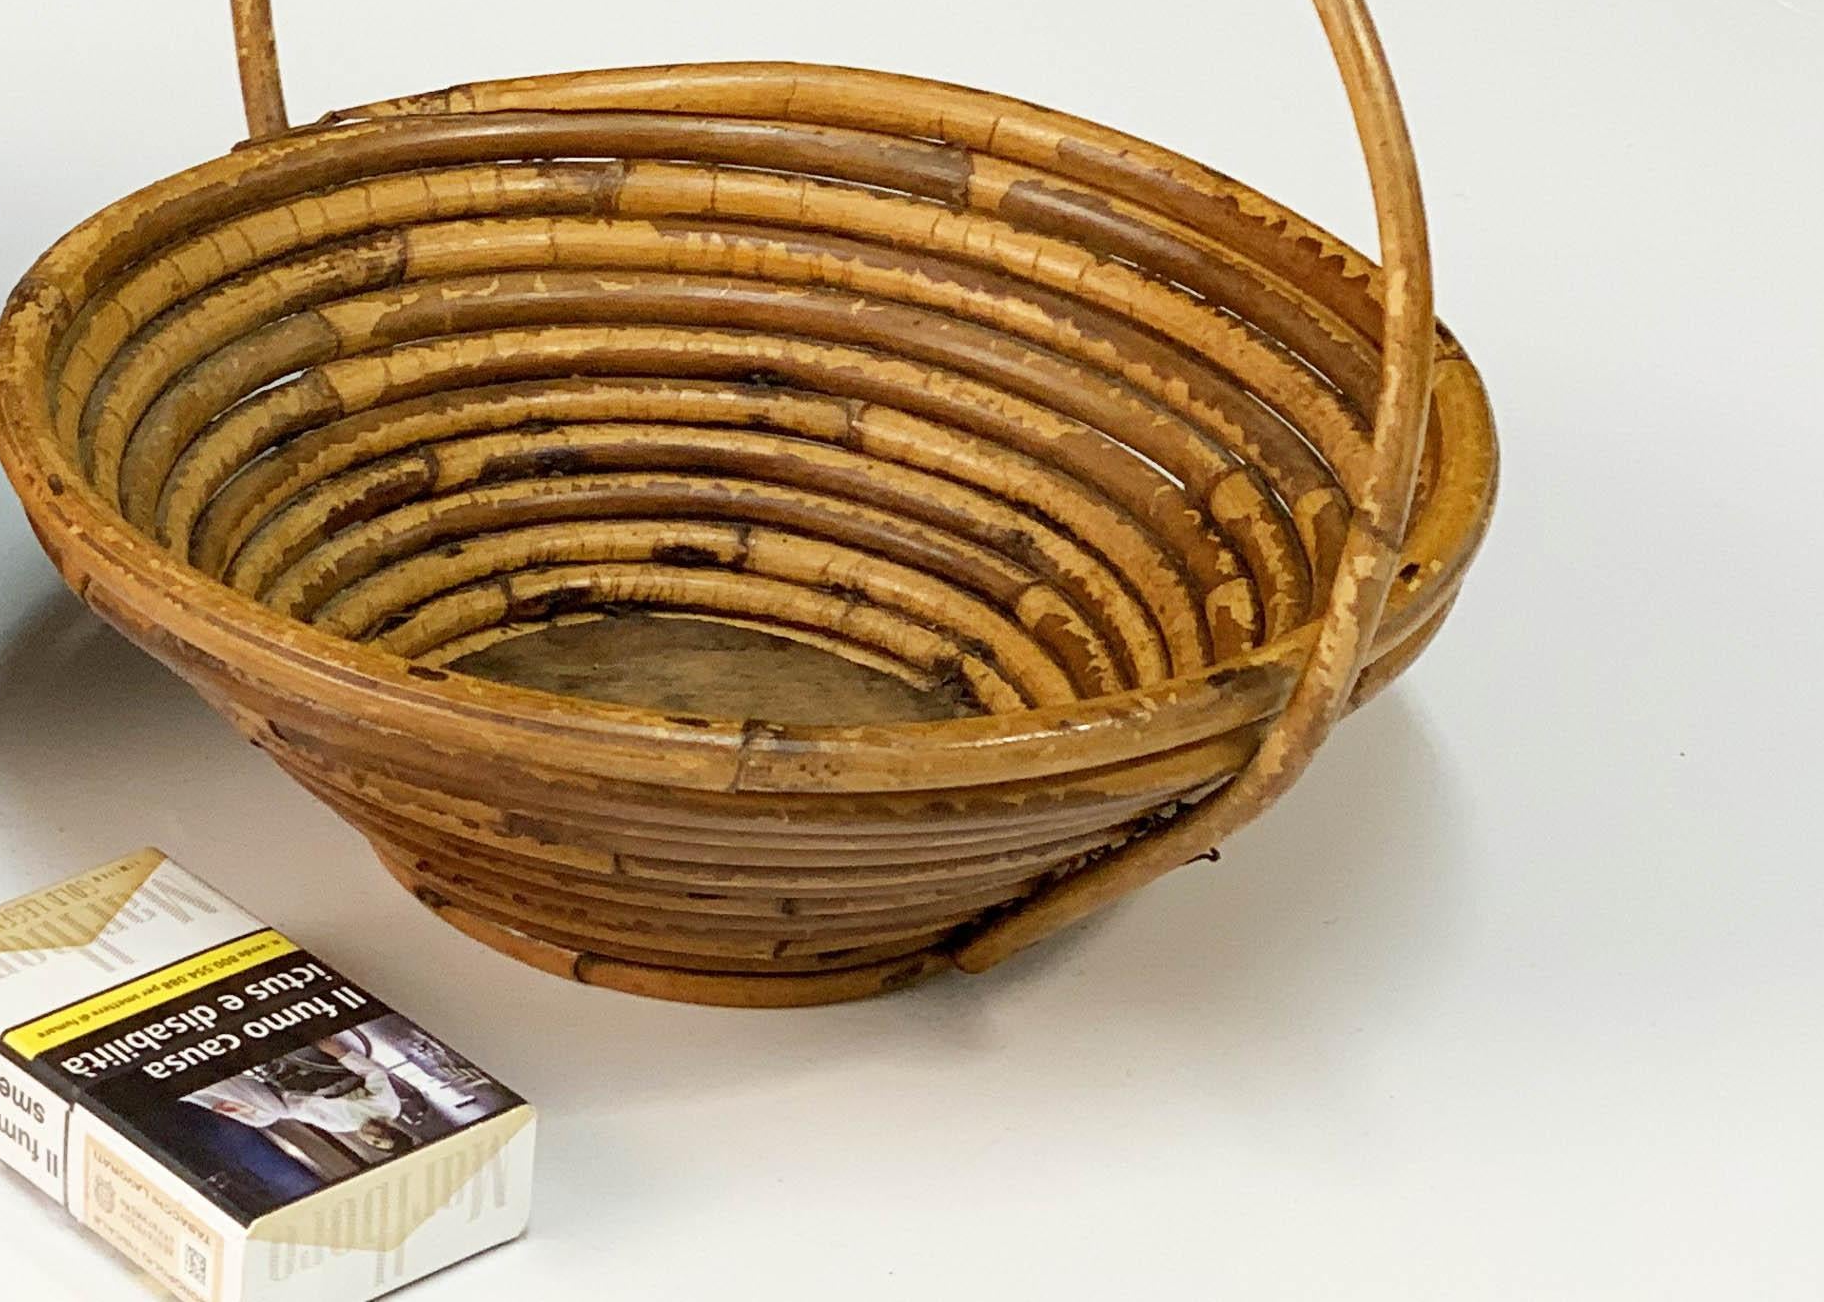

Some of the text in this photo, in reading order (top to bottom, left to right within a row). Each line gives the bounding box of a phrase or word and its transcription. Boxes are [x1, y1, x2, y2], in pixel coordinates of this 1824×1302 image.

[44, 879, 99, 907] GOLD
[142, 983, 161, 997] per
[91, 993, 141, 1016] smettere
[37, 1018, 80, 1038] fumare
[61, 963, 333, 1078] ictus e disabilità
[142, 985, 368, 1080] Il fumo causa
[46, 1149, 58, 1178] Il
[267, 1133, 505, 1286] Marlboro
